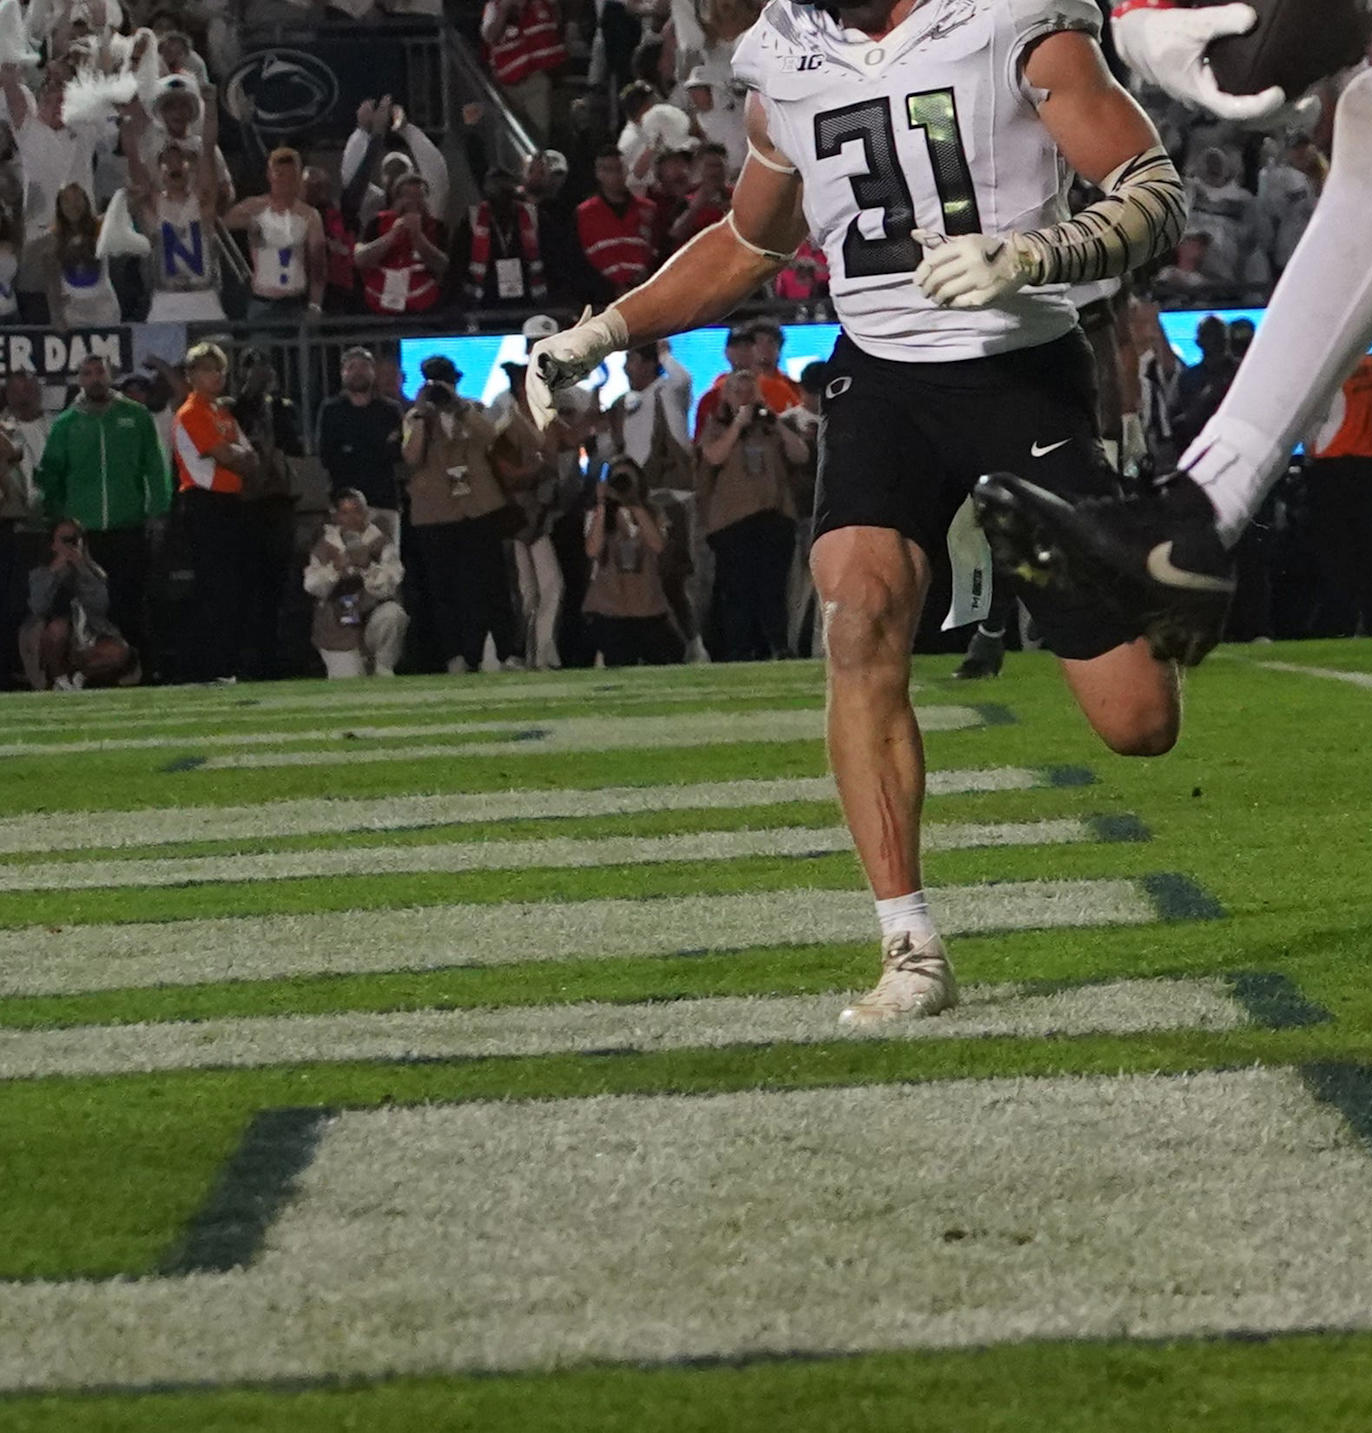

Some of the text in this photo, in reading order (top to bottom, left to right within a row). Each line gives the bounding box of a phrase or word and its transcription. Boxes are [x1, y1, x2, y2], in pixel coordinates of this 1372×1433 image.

[814, 86, 983, 279] 31
[161, 220, 205, 278] N
[43, 333, 122, 373] DAM
